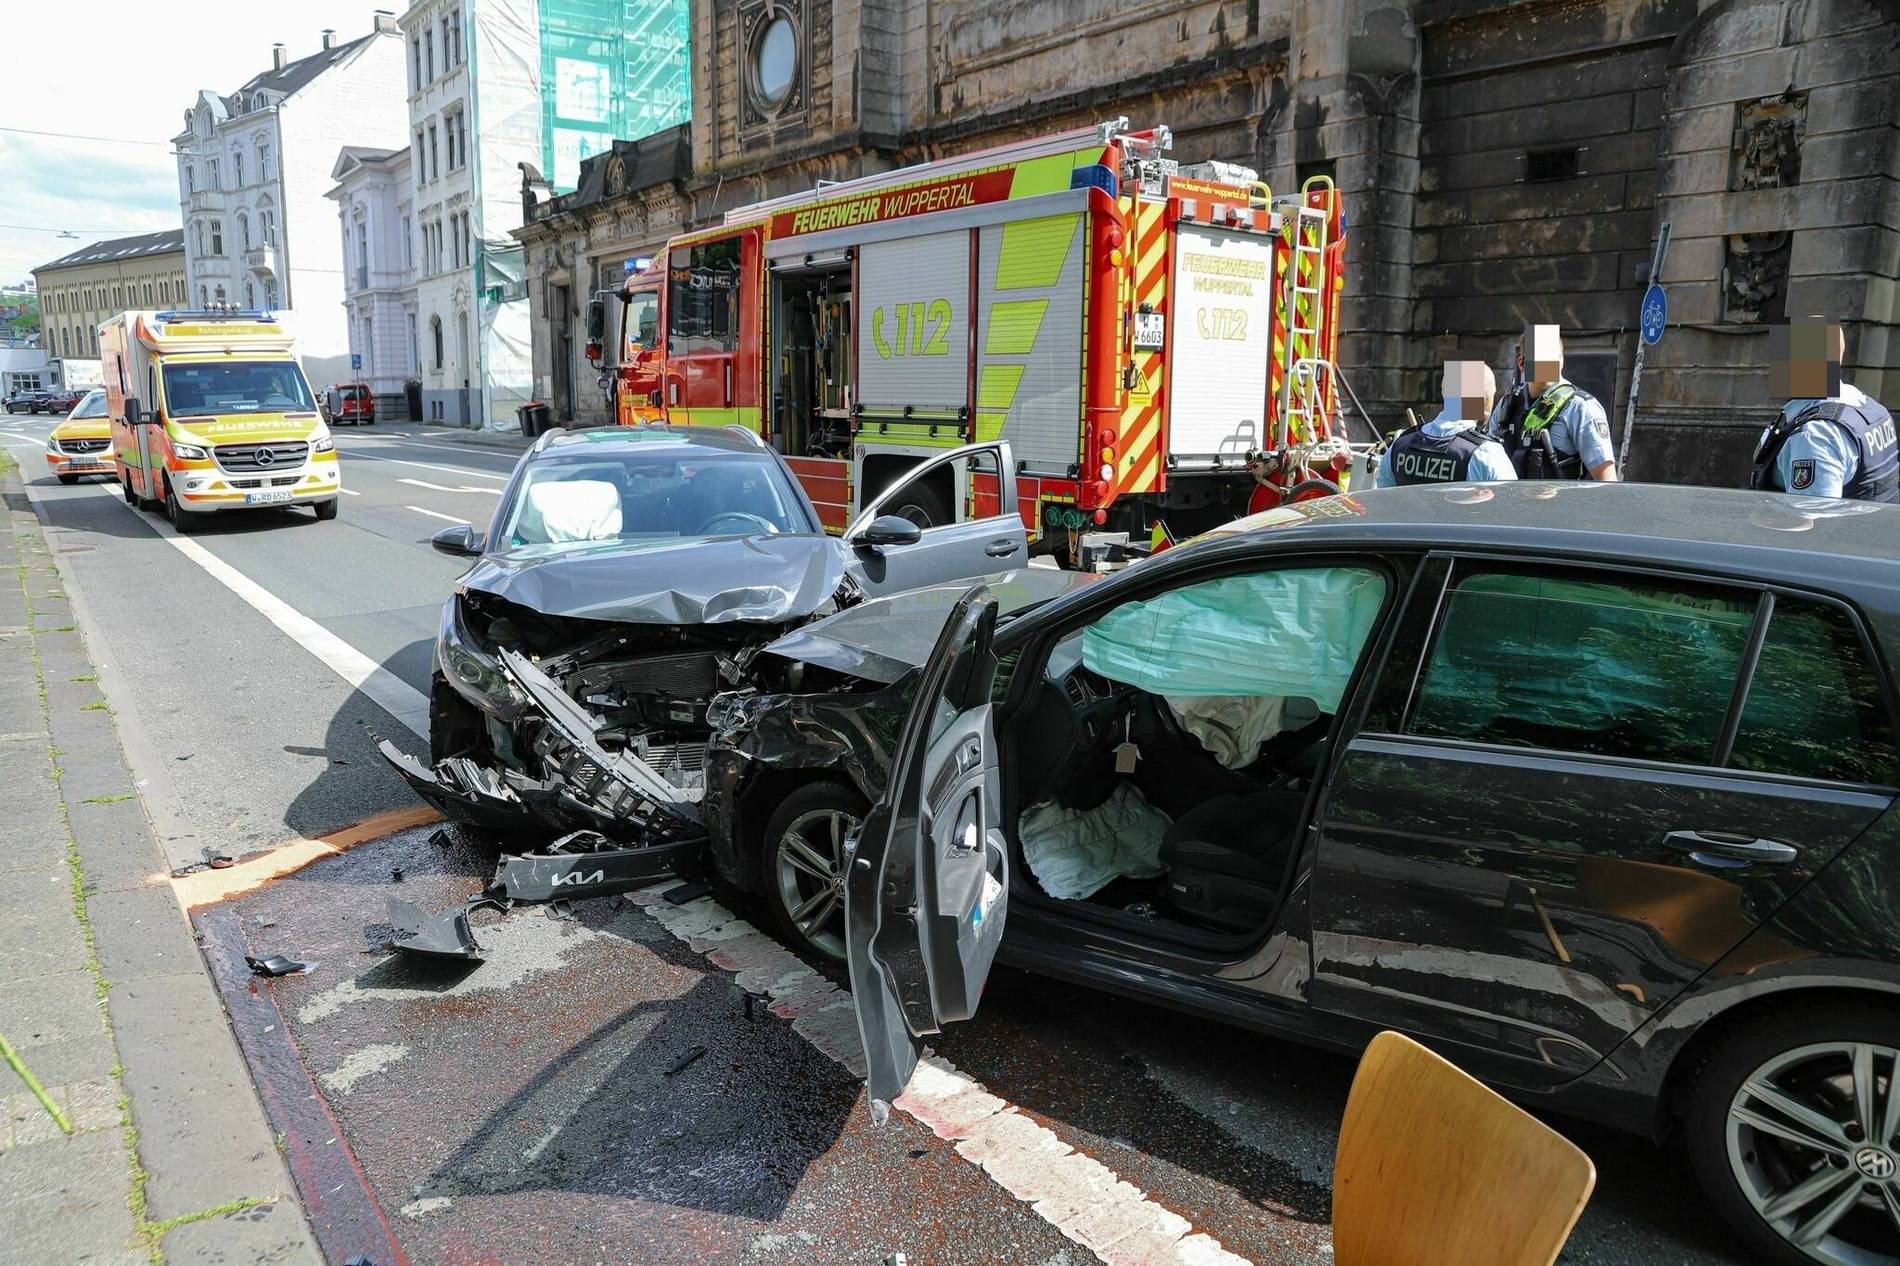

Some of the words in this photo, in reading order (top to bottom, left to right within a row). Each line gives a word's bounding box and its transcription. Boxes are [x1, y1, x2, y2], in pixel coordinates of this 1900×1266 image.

[792, 198, 881, 234] FEUERWEHR
[884, 181, 977, 219] WUPPERTAL
[1182, 252, 1266, 281] FEUERWEHR
[1193, 276, 1254, 297] WUPPERTAL
[894, 298, 953, 357] 112
[1140, 330, 1163, 344] 6603
[1211, 307, 1249, 341] 112
[1396, 453, 1457, 481] POLIZEI
